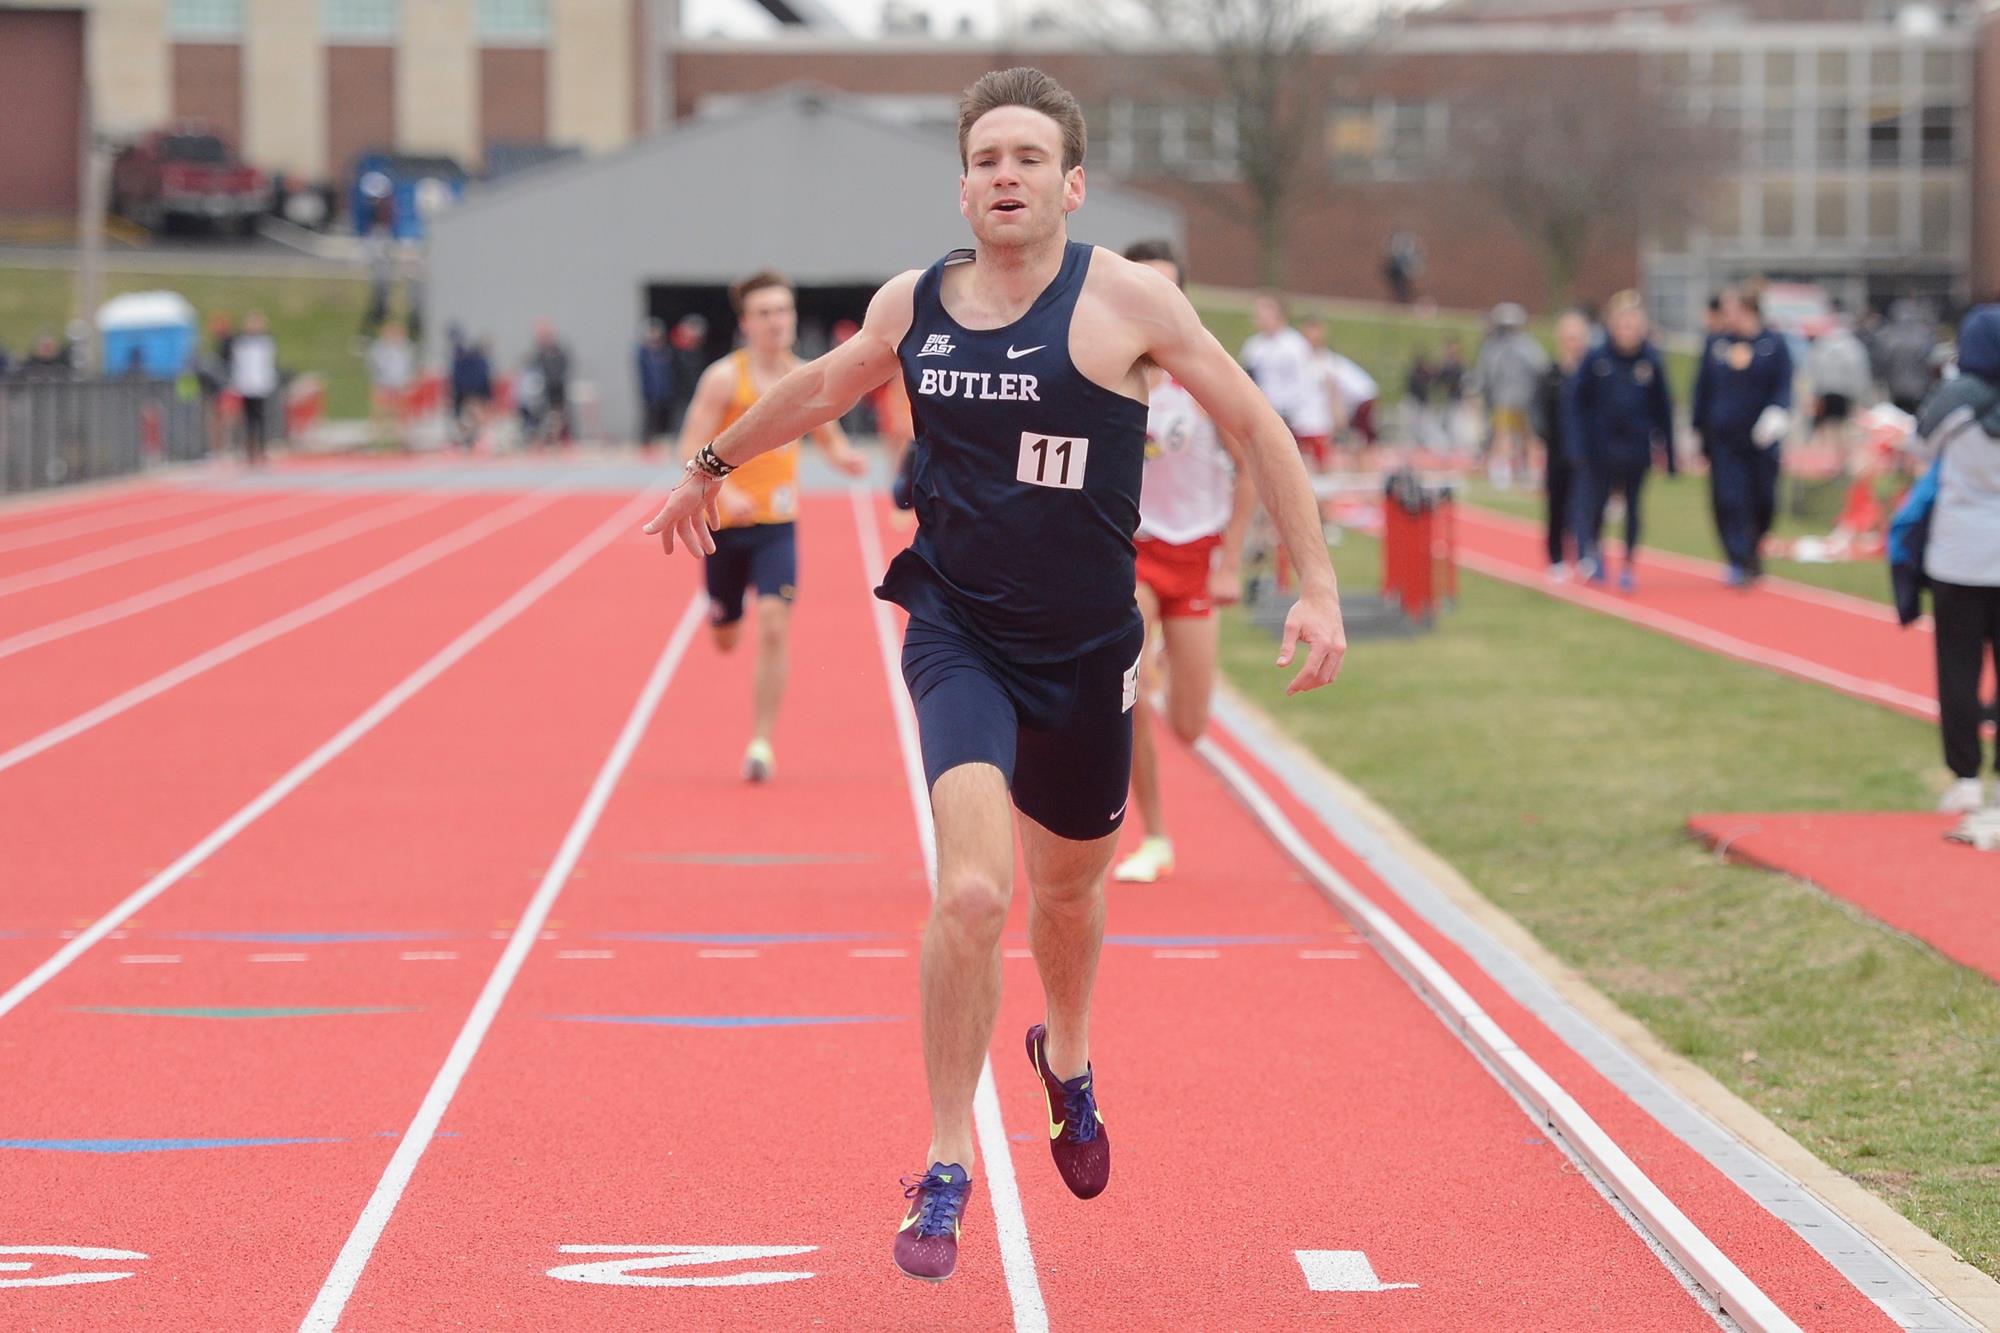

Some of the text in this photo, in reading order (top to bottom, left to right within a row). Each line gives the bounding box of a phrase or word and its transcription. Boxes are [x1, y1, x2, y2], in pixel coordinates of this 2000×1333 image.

[920, 344, 956, 354] EAST
[926, 334, 951, 344] BIG
[918, 368, 1040, 401] BUTLER
[1032, 439, 1072, 485] 11
[545, 1244, 819, 1287] 2
[1294, 1249, 1420, 1292] 1
